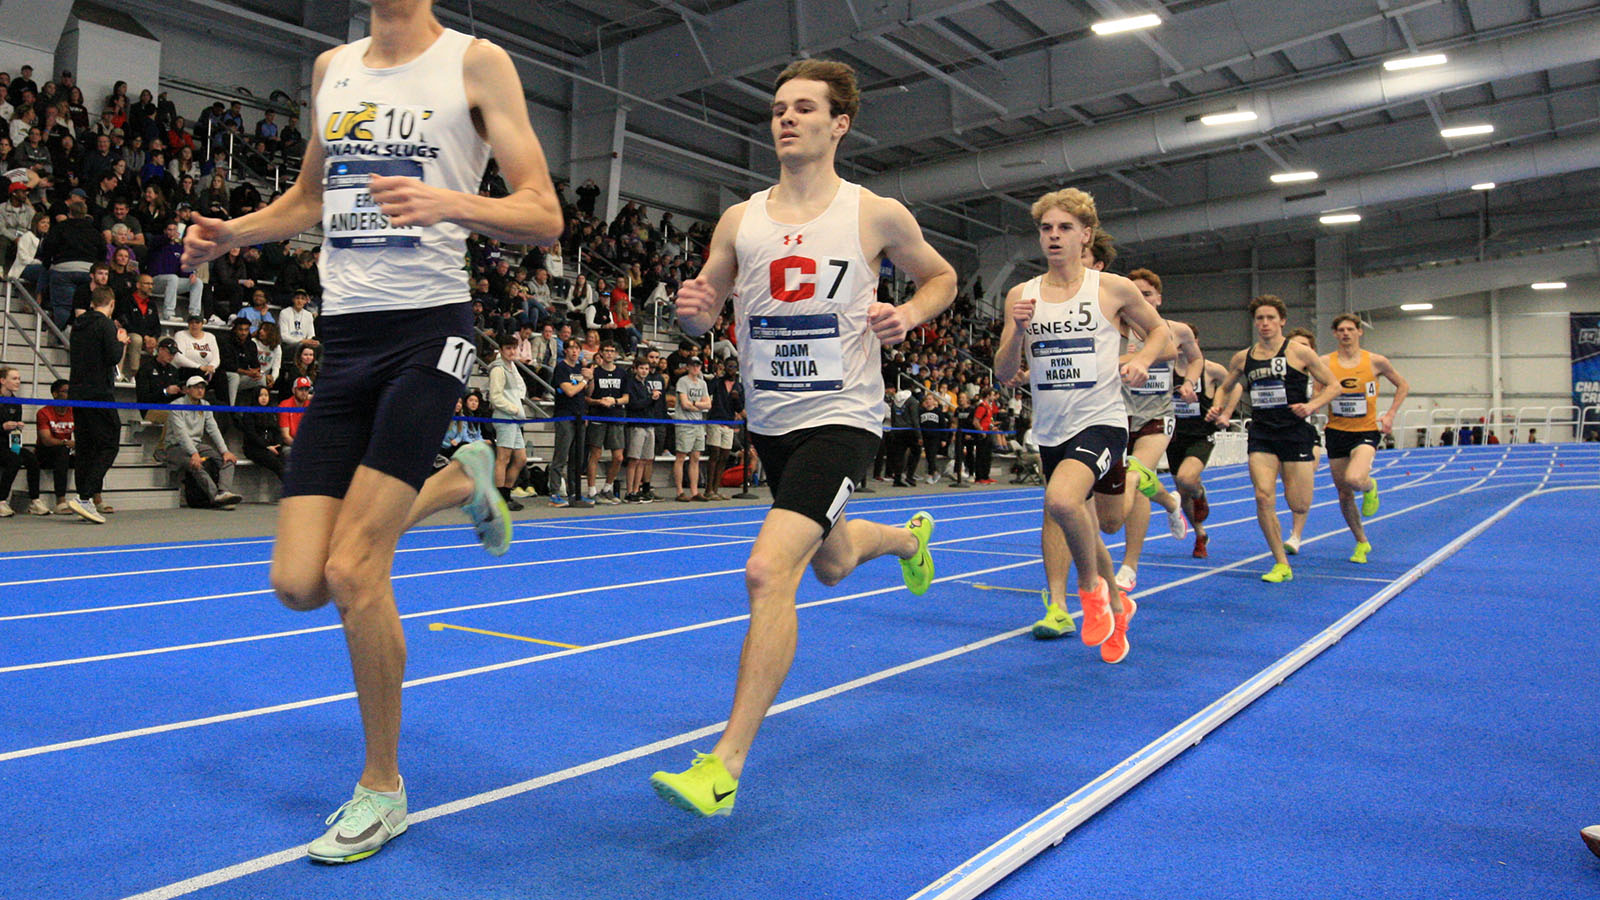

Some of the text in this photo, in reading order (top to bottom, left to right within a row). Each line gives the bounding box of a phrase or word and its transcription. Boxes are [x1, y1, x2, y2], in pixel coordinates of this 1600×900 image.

[385, 108, 415, 140] 10
[382, 144, 440, 159] SLUGS
[329, 212, 413, 232] ANDERS
[769, 255, 816, 303] C
[826, 259, 849, 299] 7
[1078, 302, 1092, 326] 5
[775, 343, 809, 357] ADAM
[770, 360, 819, 377] SYLVIA
[1050, 357, 1073, 368] RYAN
[1274, 358, 1284, 373] 8
[1045, 367, 1081, 381] HAGAN
[1368, 382, 1375, 396] 4
[1575, 381, 1600, 393] CHA
[1581, 392, 1600, 404] CR
[1166, 418, 1174, 436] 6
